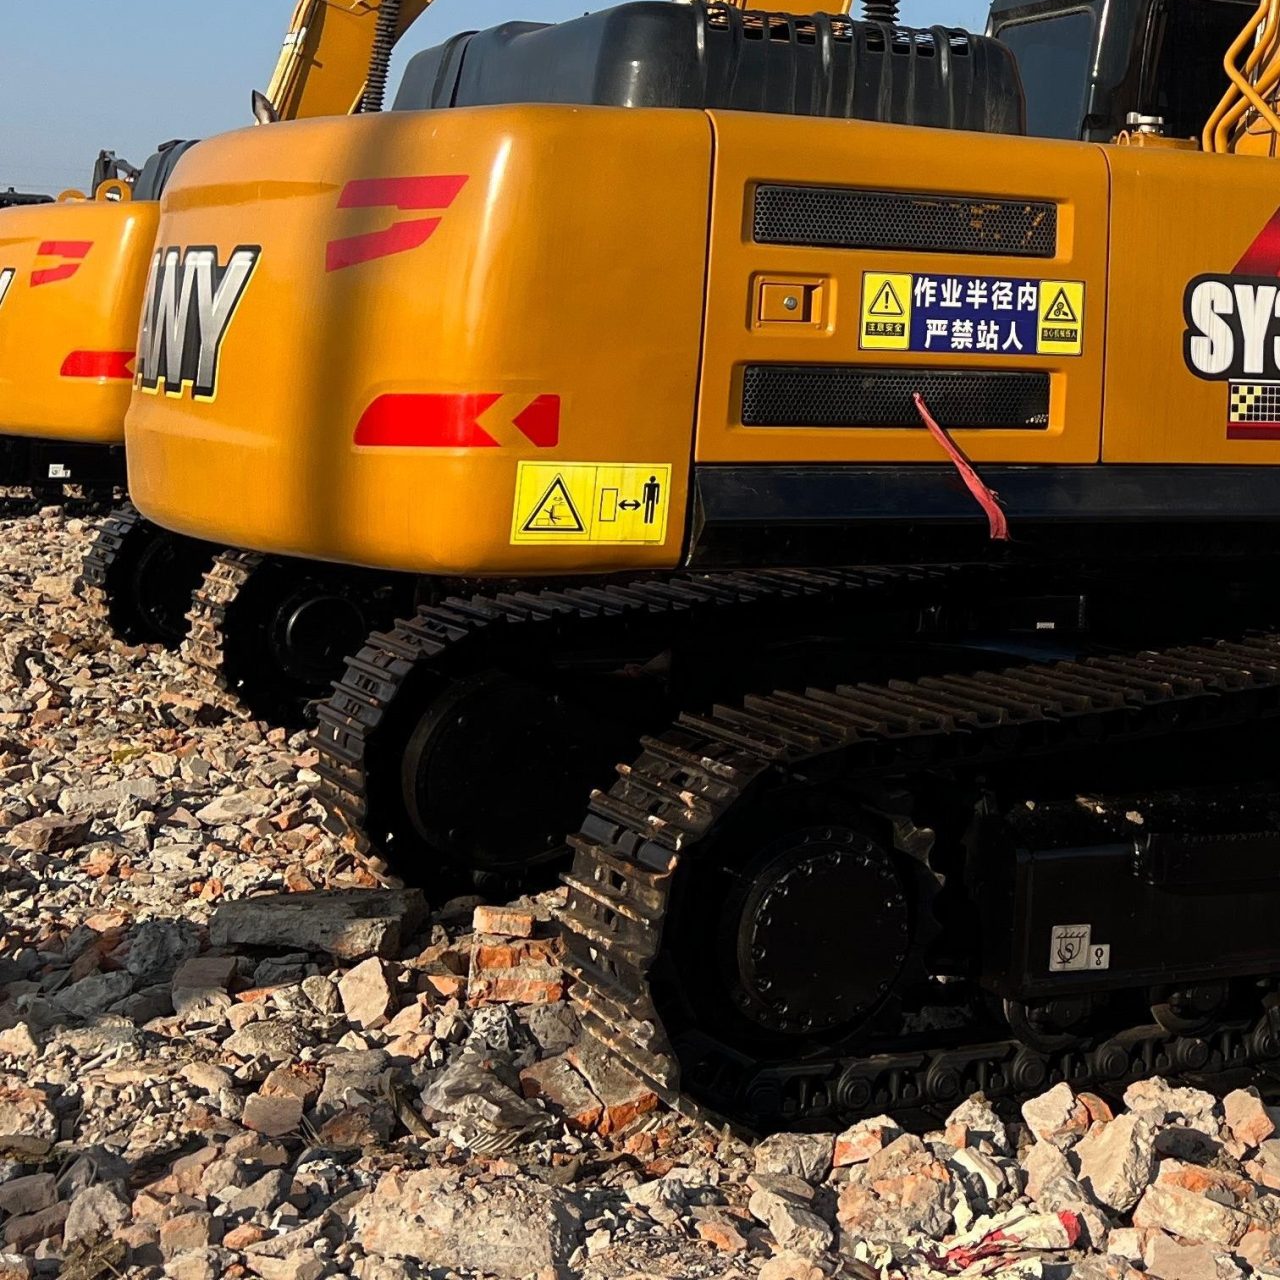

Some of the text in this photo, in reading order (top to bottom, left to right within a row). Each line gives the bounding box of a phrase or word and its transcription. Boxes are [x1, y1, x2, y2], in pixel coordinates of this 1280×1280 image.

[914, 277, 1037, 311] 作业半径内
[135, 247, 258, 396] ANY
[924, 319, 1023, 351] 严禁站人
